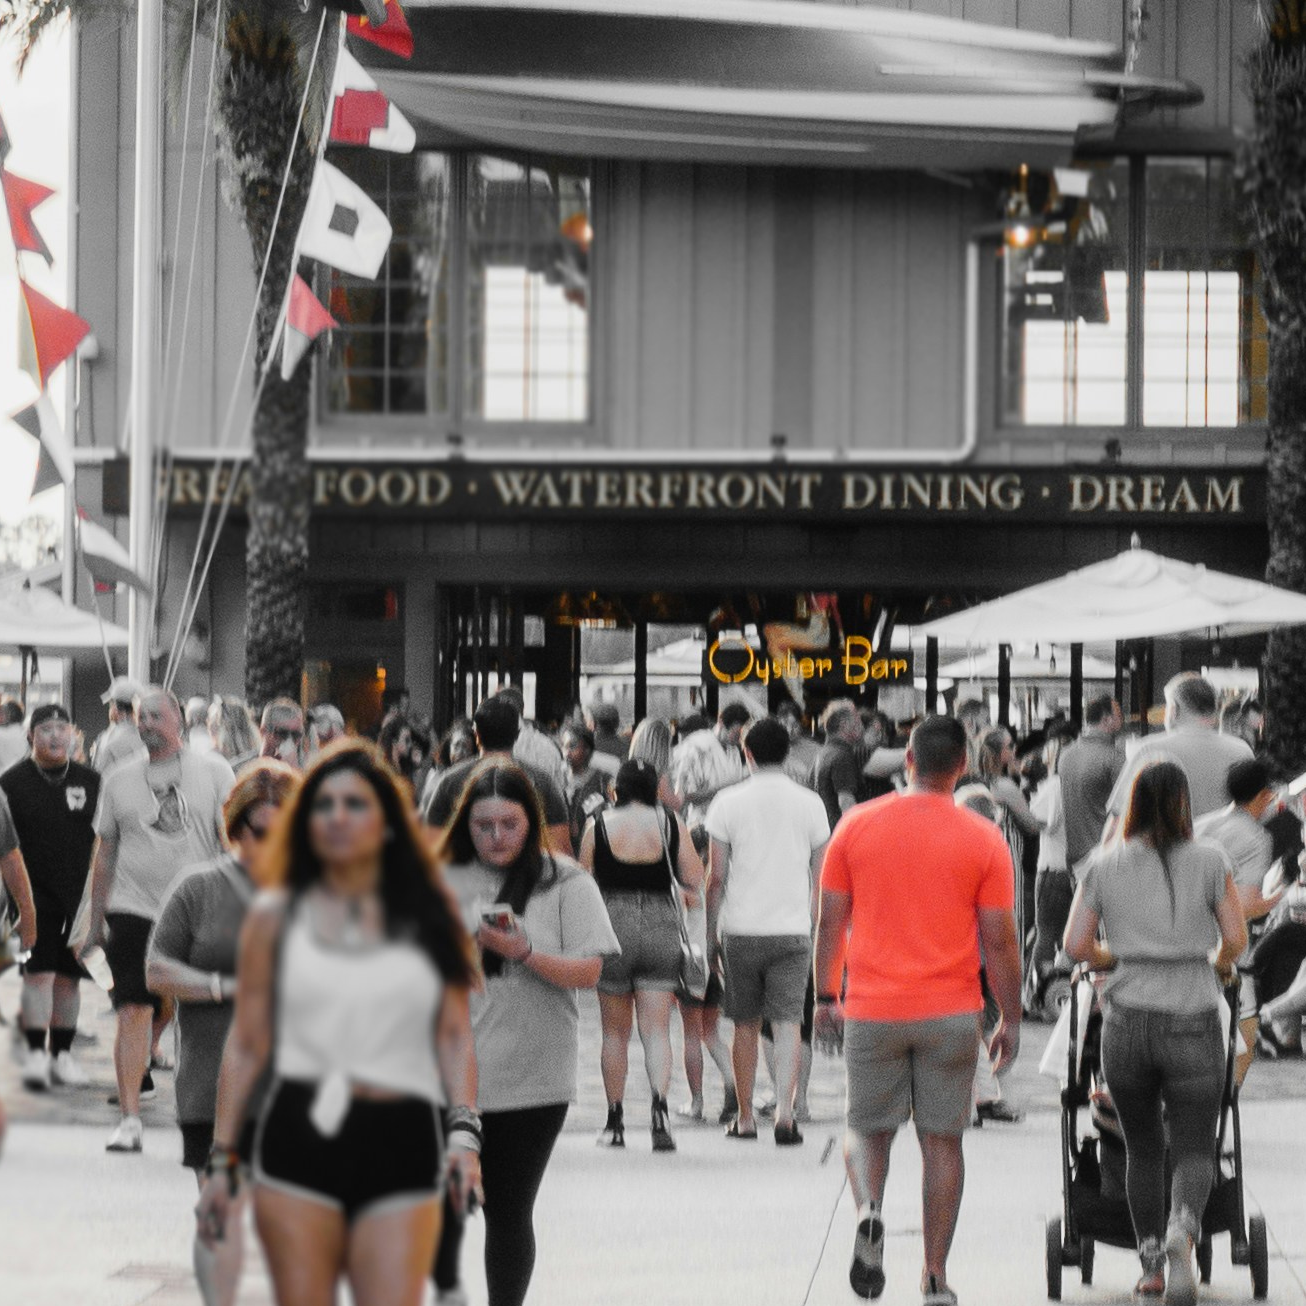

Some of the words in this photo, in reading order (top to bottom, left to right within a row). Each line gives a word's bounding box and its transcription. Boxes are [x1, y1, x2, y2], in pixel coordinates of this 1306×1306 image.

[313, 469, 452, 507] FOOD
[491, 470, 823, 508] WATERFRONT
[842, 472, 1025, 511] DINING
[1069, 475, 1245, 514] DREAM
[708, 637, 833, 686] Oyster
[841, 635, 908, 685] Bar
